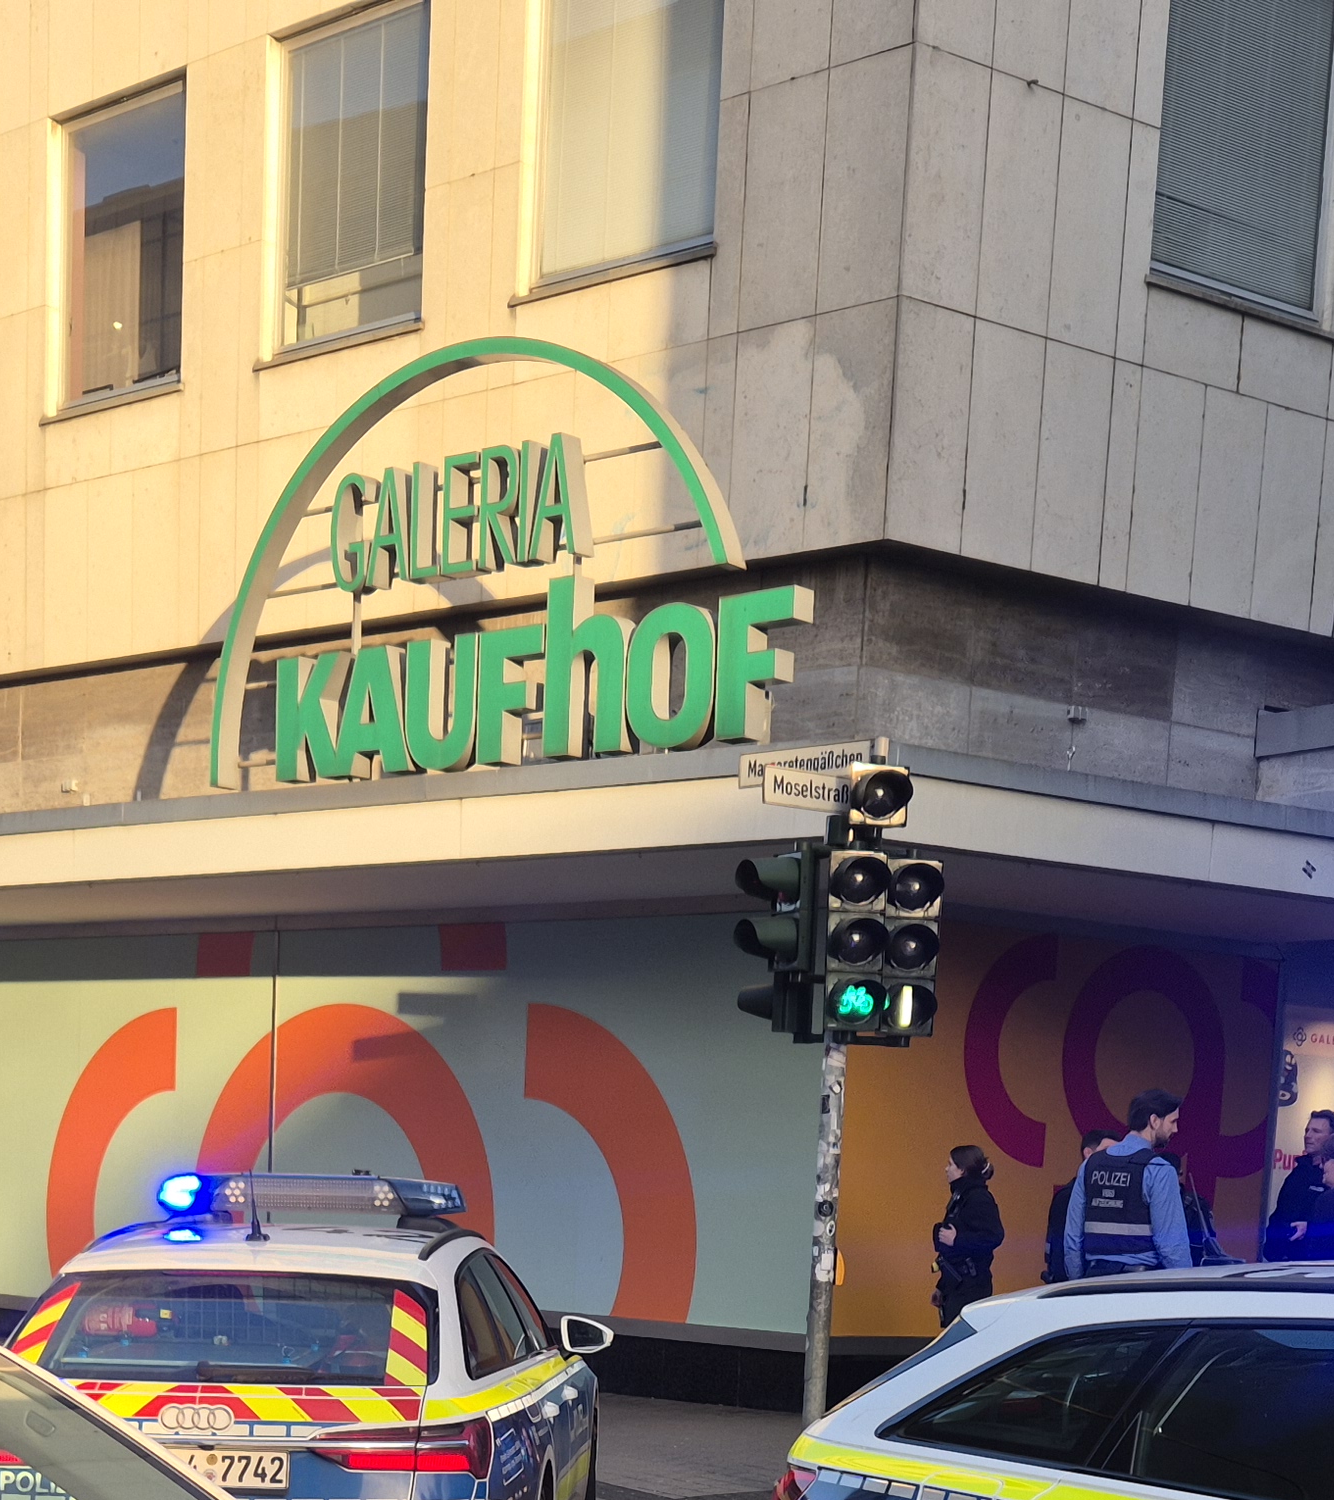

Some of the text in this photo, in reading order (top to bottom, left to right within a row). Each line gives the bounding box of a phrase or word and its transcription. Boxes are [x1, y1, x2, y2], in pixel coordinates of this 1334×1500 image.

[330, 432, 581, 594] GALERIA
[276, 575, 799, 783] KAUFhOF
[747, 748, 863, 778] Maretengäßchen
[773, 774, 849, 804] Moselstraß
[1091, 1170, 1131, 1187] POLIZEI
[0, 1470, 67, 1494] POLI
[220, 1455, 285, 1484] 7742
